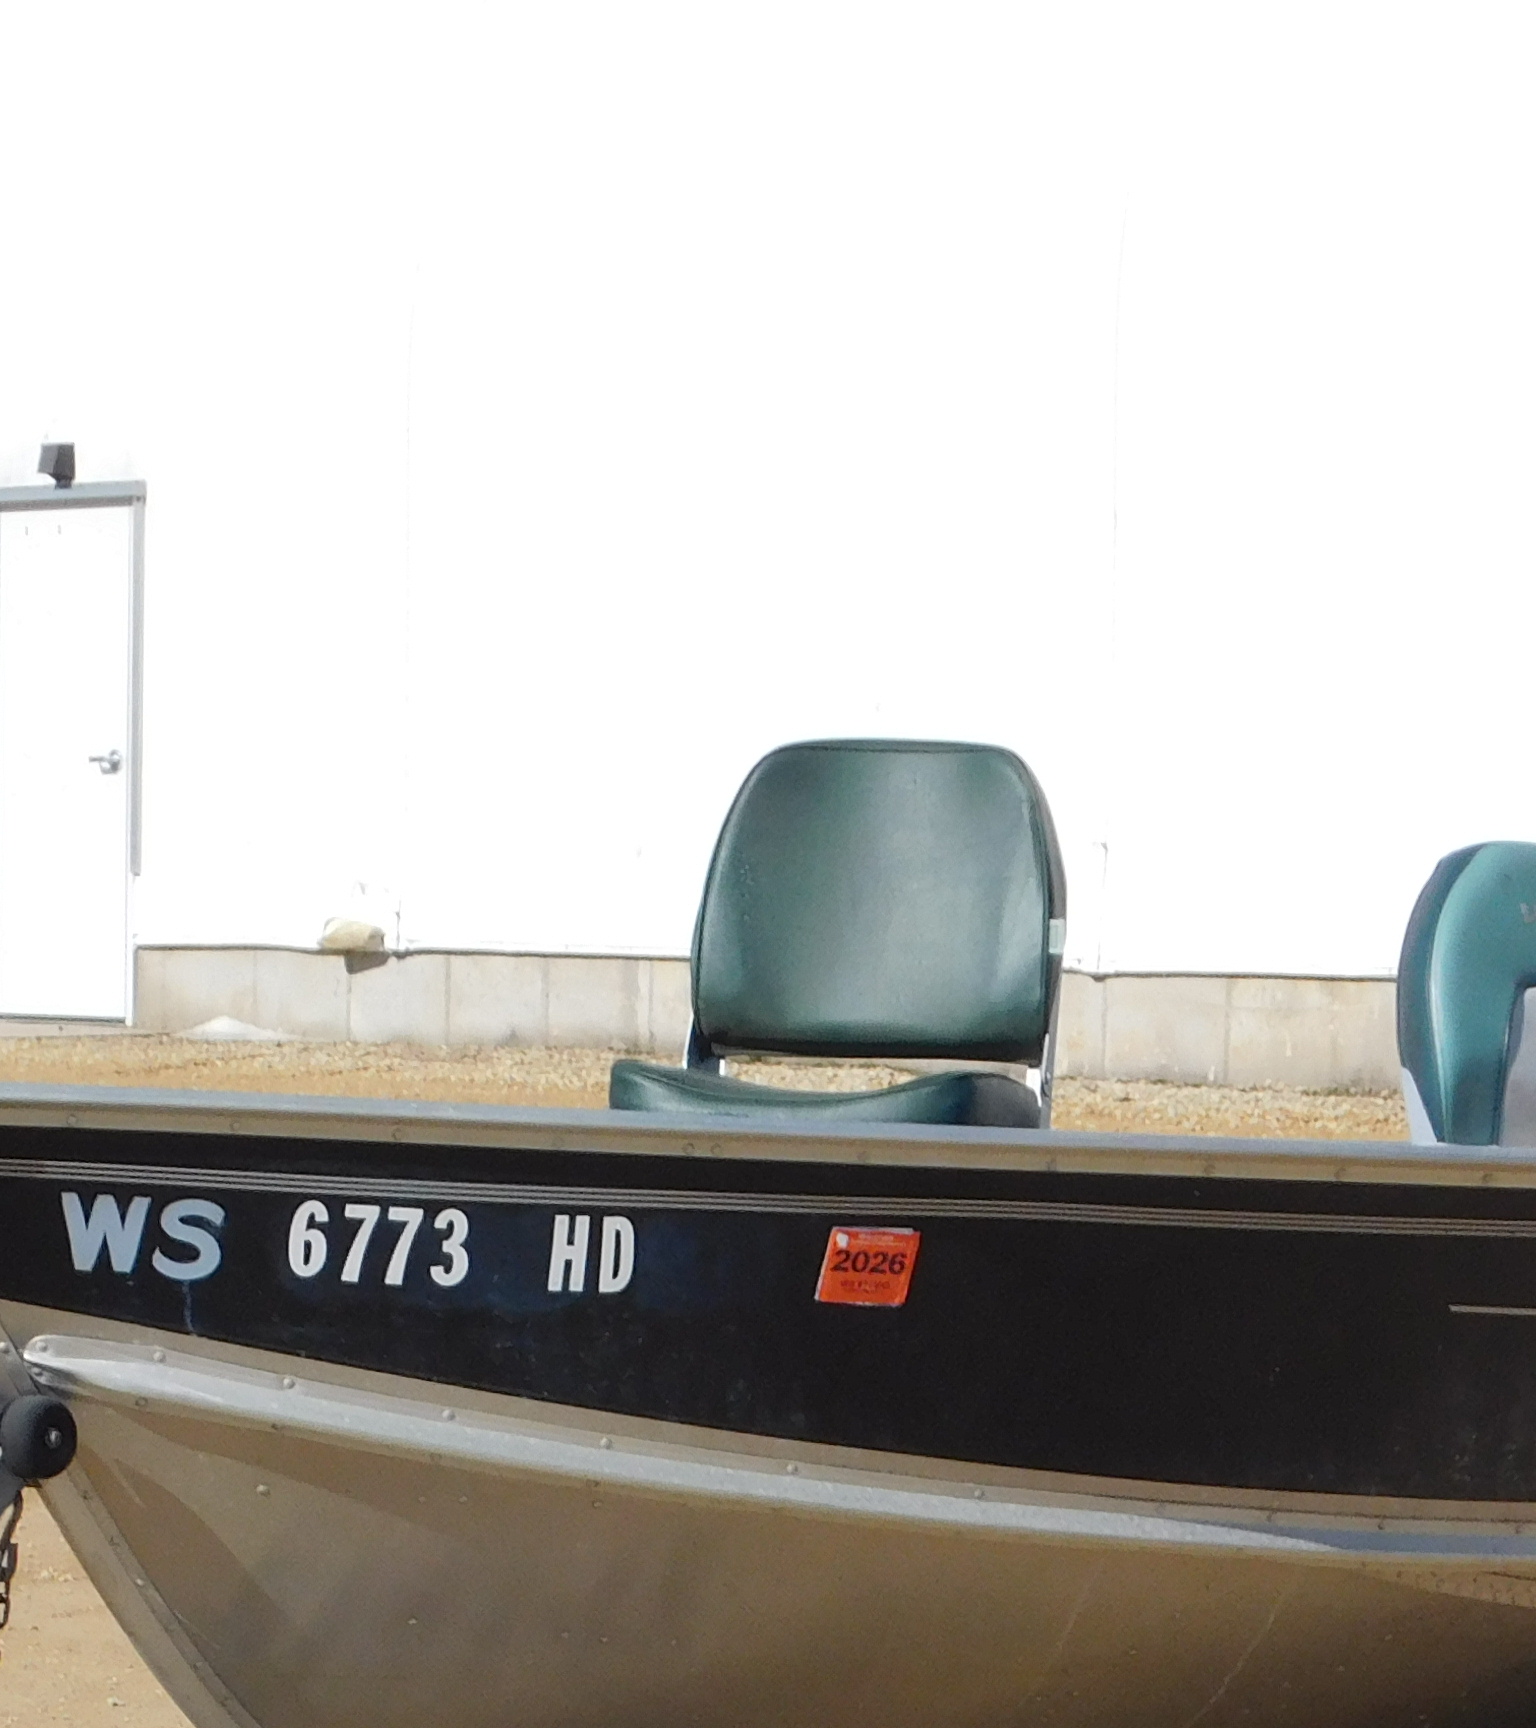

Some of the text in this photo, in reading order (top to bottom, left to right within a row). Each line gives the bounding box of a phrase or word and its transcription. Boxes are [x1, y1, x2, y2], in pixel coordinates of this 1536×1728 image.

[61, 1191, 636, 1293] WS 6773 HD
[830, 1249, 907, 1275] 2026
